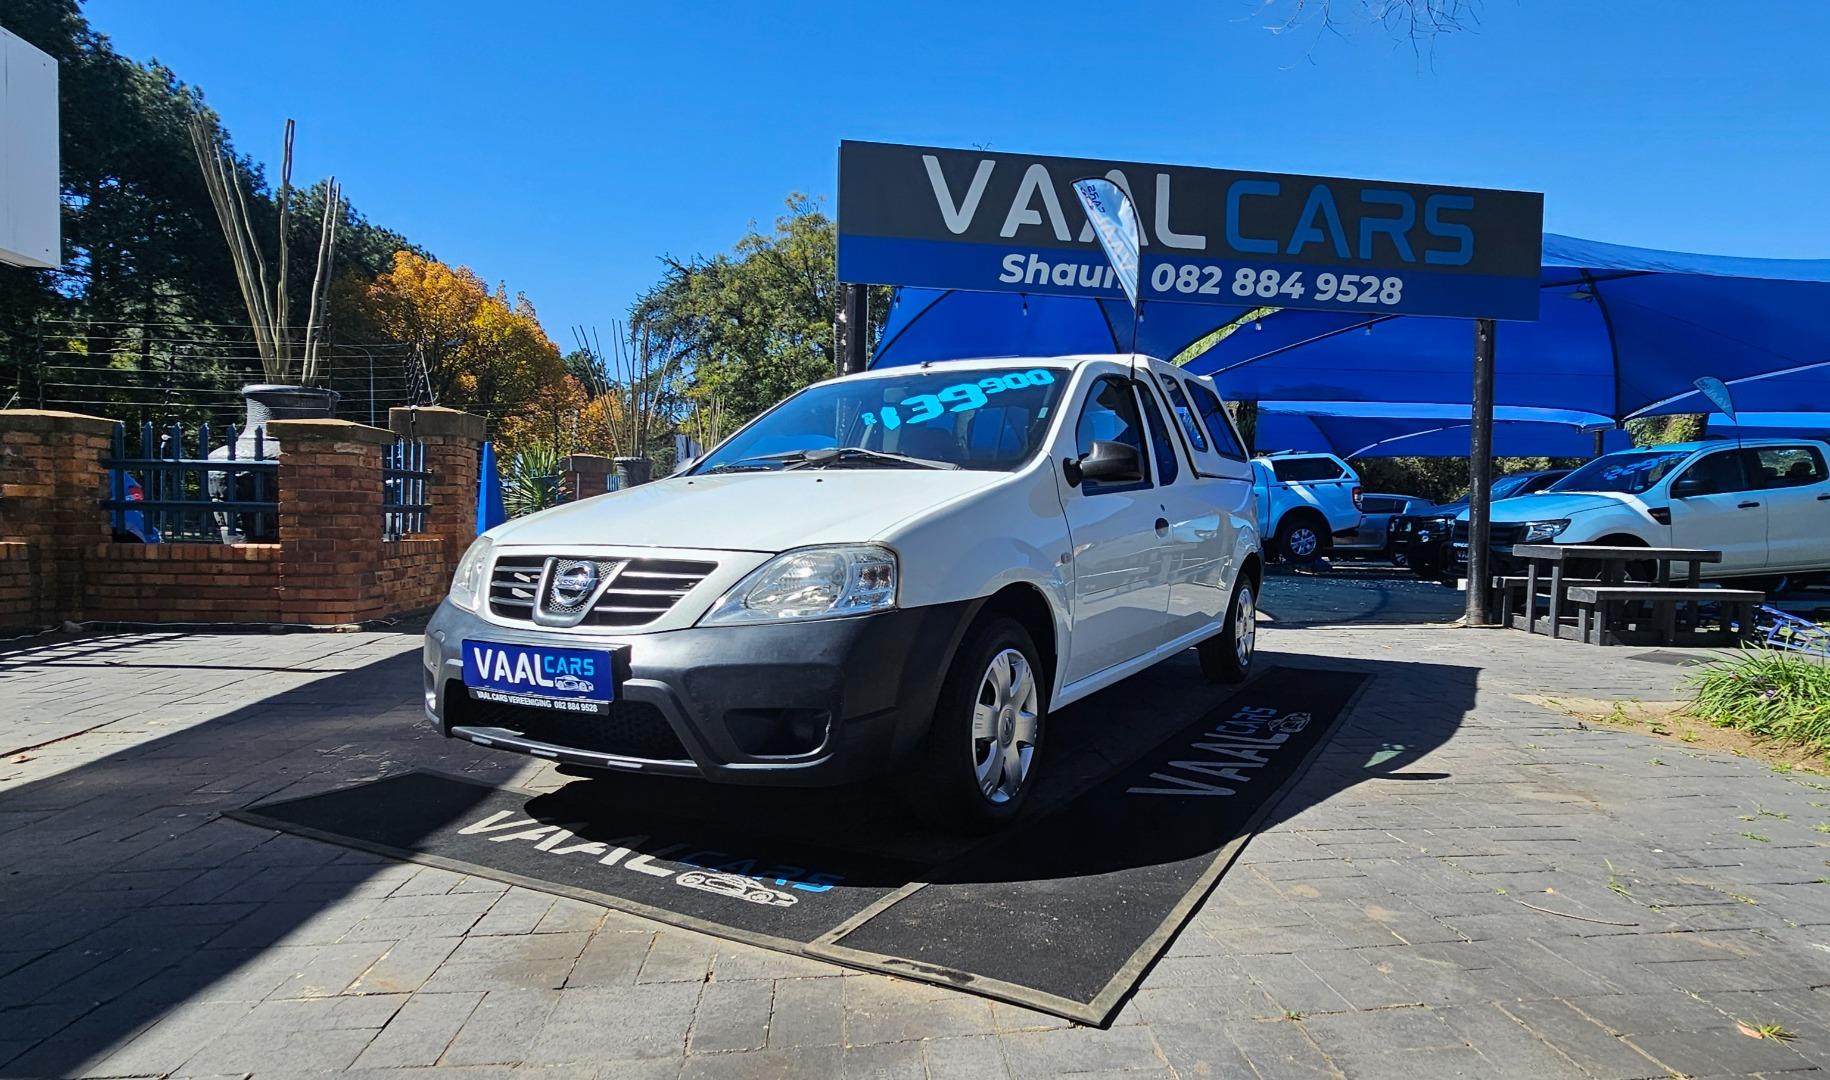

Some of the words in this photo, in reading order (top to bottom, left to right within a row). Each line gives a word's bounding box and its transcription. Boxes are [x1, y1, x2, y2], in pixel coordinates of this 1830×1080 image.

[1226, 179, 1474, 265] CARS
[1151, 263, 1223, 295] 082
[1231, 267, 1305, 299] 884
[1314, 272, 1403, 305] 9528
[473, 647, 554, 688] VAAL
[544, 655, 595, 677] CARS
[491, 693, 508, 703] CARS
[553, 701, 566, 710] 082
[567, 702, 580, 711] 884
[580, 703, 599, 713] 9528
[1126, 732, 1291, 796] VAAL
